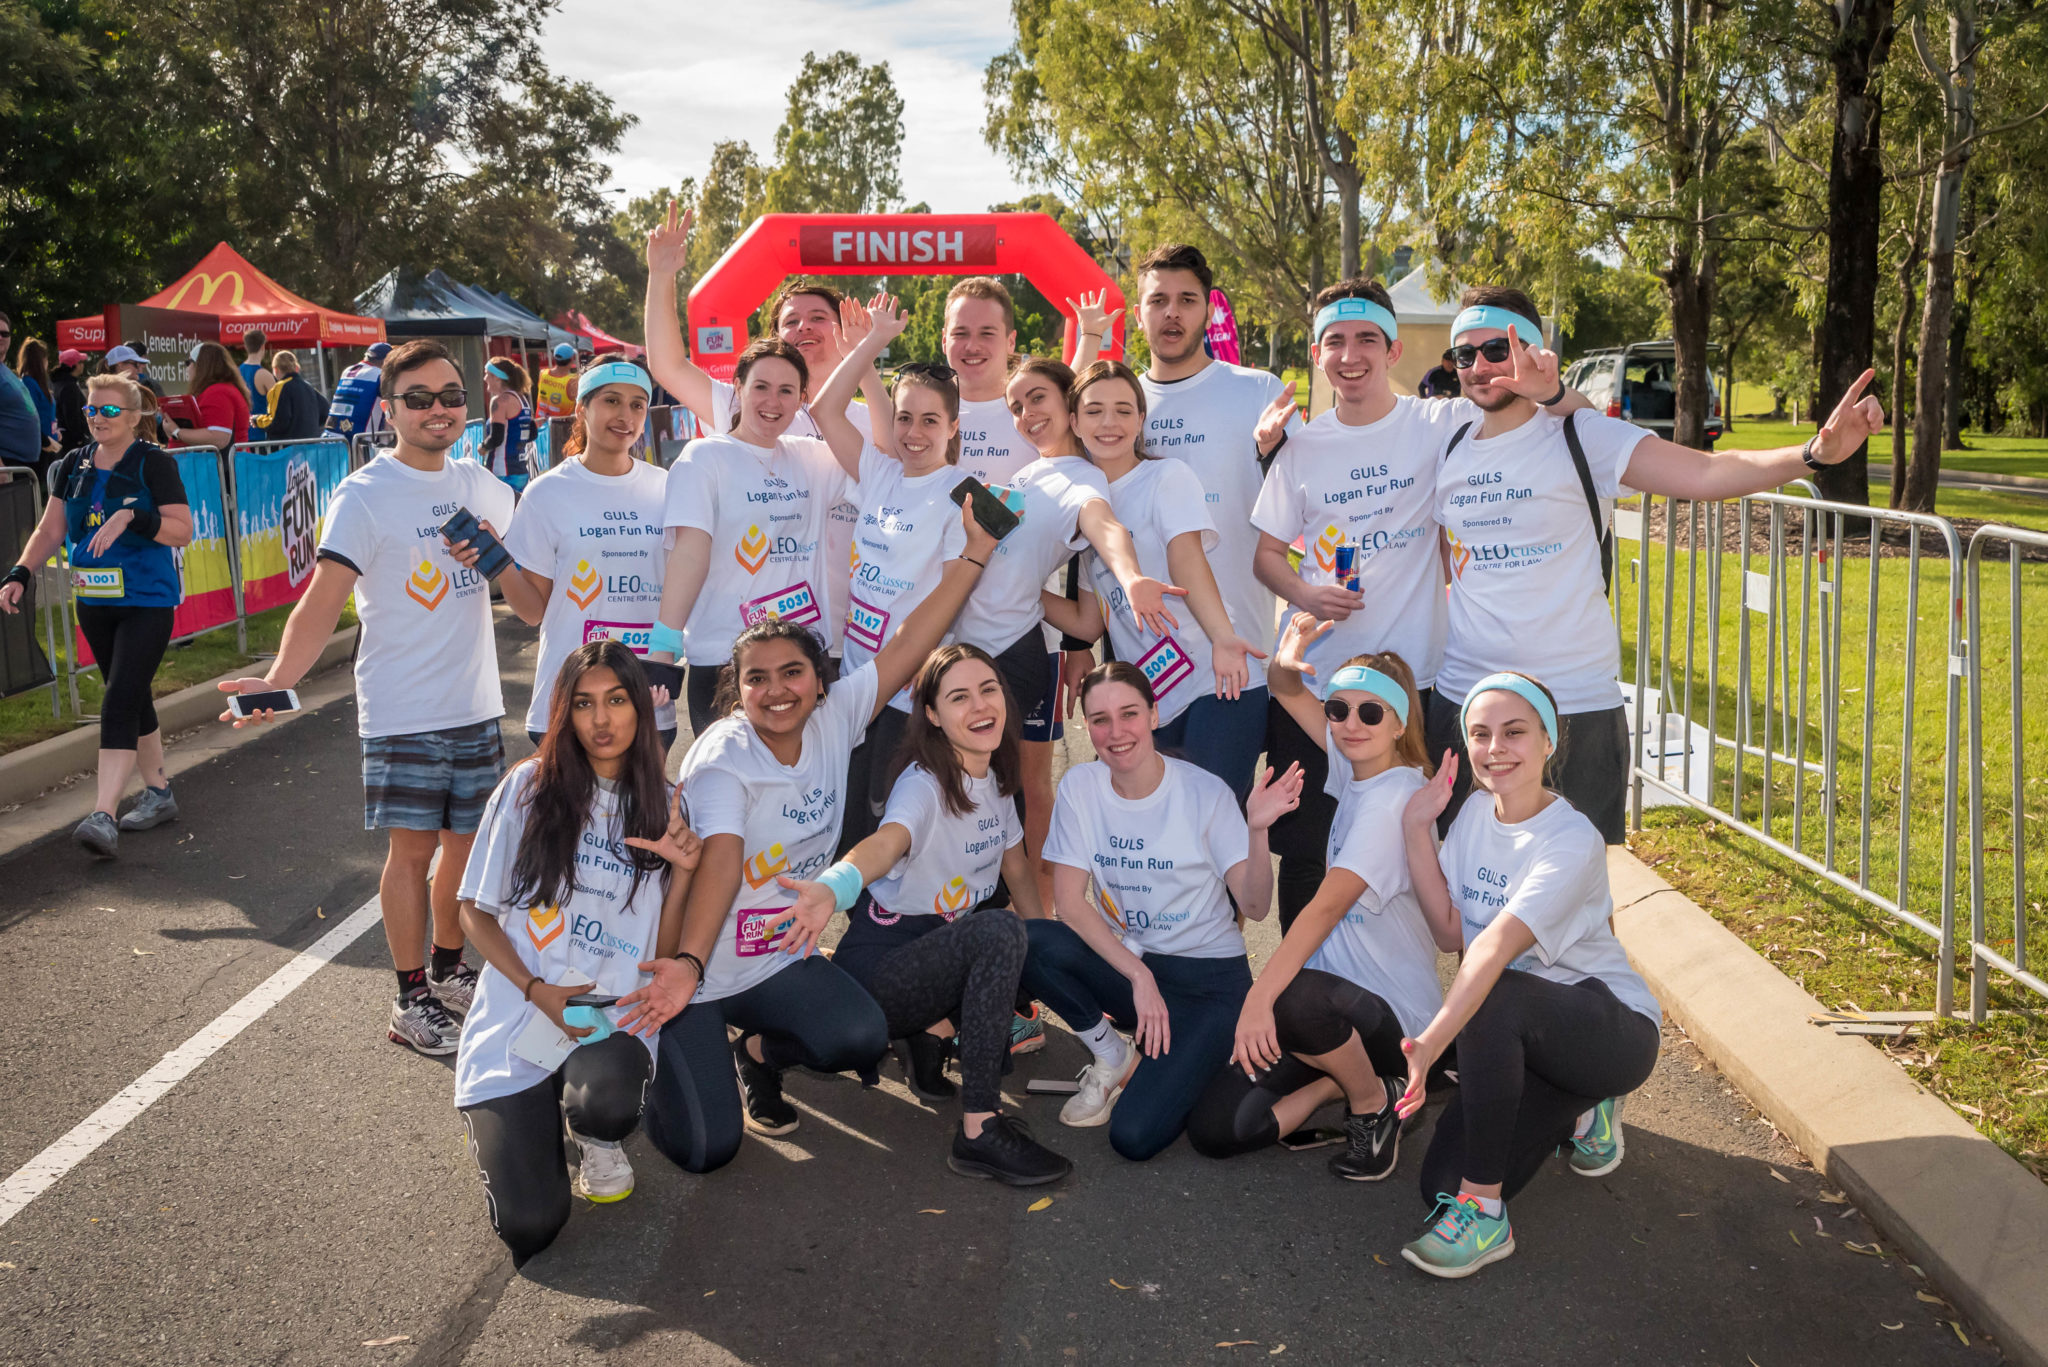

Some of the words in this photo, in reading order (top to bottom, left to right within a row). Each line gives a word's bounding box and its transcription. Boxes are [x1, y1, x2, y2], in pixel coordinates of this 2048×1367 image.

[832, 231, 964, 262] FINISH
[706, 335, 723, 345] FUN
[1151, 418, 1184, 430] GULS
[1162, 435, 1181, 446] Fun
[1184, 433, 1205, 444] Run
[963, 446, 983, 456] Fun
[987, 446, 1009, 456] Run
[1350, 464, 1388, 480] GULS
[1467, 471, 1502, 486] GULS
[1324, 488, 1362, 504] Logan
[1390, 477, 1414, 490] Run
[1449, 492, 1477, 507] Logan
[1480, 491, 1502, 503] Fun
[1506, 488, 1533, 500] Run
[282, 480, 315, 549] FUN
[432, 502, 458, 517] GULS
[603, 511, 639, 521] GULS
[1385, 506, 1394, 514] By
[831, 514, 846, 522] FOR
[1462, 518, 1500, 528] Sponsored
[1502, 516, 1512, 525] By
[579, 526, 616, 538] Logan
[619, 525, 642, 536] Fun
[290, 528, 314, 579] RUN
[601, 550, 638, 559] Sponsored
[639, 550, 649, 559] By
[1472, 542, 1563, 562] LEOcussen
[1473, 562, 1502, 571] CENTRE
[1504, 560, 1520, 568] FOR
[1521, 558, 1542, 567] LAW
[87, 574, 115, 584] 1001
[859, 562, 915, 591] EOcussen
[882, 588, 897, 597] LAW
[749, 606, 767, 623] FUN
[778, 591, 809, 613] 5039
[853, 609, 880, 630] 5147
[589, 630, 609, 642] FUN
[1144, 648, 1175, 679] 5094
[978, 815, 999, 832] GULS
[583, 832, 623, 855] GULS
[965, 838, 989, 855] Logan
[1109, 835, 1144, 851] GULS
[594, 855, 620, 873] Fun
[623, 863, 650, 882] Rn
[1094, 853, 1117, 868] ogan
[1121, 857, 1143, 869] Fun
[1147, 857, 1174, 870] Run
[1477, 866, 1508, 888] GULS
[605, 890, 617, 901] By
[1141, 885, 1152, 894] By
[1462, 884, 1479, 900] ogan
[743, 919, 766, 933] FUN
[746, 930, 763, 940] RUN
[588, 946, 604, 957] FOR
